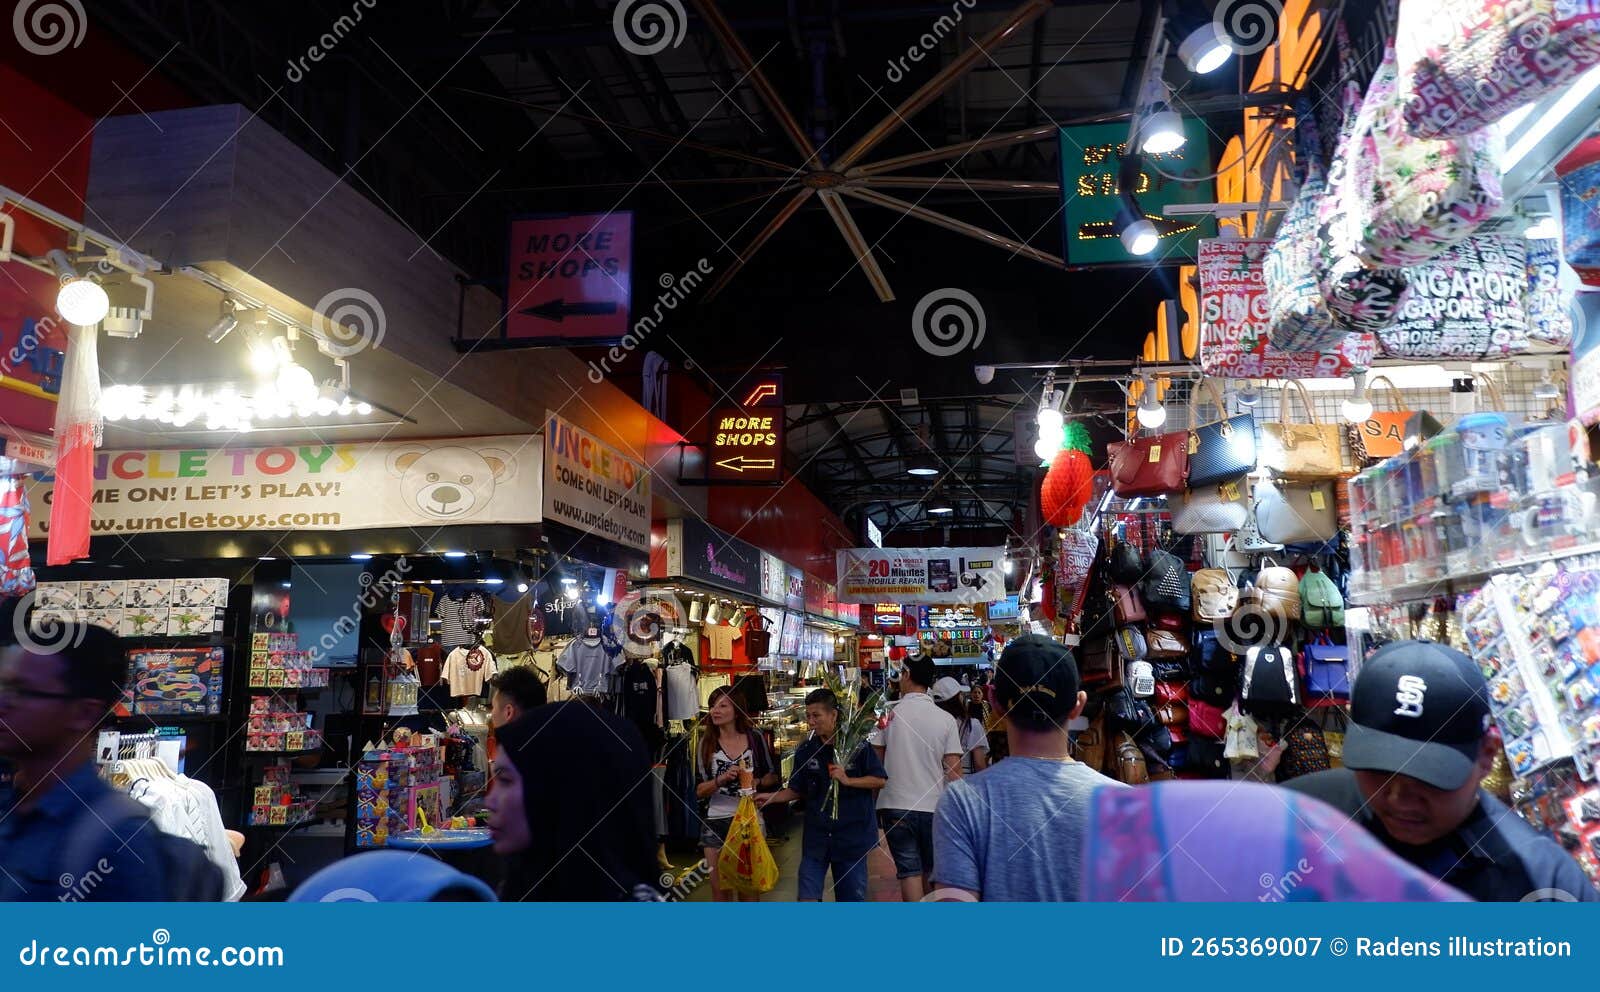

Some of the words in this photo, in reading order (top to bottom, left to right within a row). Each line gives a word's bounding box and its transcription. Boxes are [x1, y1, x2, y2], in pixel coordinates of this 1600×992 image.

[525, 230, 615, 254] MORE
[518, 257, 620, 282] SHOPS
[719, 416, 773, 430] MORE
[550, 418, 611, 479] UNCLE
[715, 432, 777, 446] SHOPS
[225, 445, 359, 476] TOYS
[128, 483, 177, 503] ON!
[186, 484, 252, 501] LET'S
[260, 481, 342, 499] PLAY!
[555, 464, 584, 491] COME
[586, 479, 602, 500] ON!
[624, 498, 646, 519] PLAY!
[868, 559, 890, 578] 20
[891, 567, 925, 577] Minutes
[867, 577, 896, 585] MOBILE
[898, 577, 925, 585] REPAIR
[938, 630, 956, 640] FOOD
[957, 629, 982, 639] STREET
